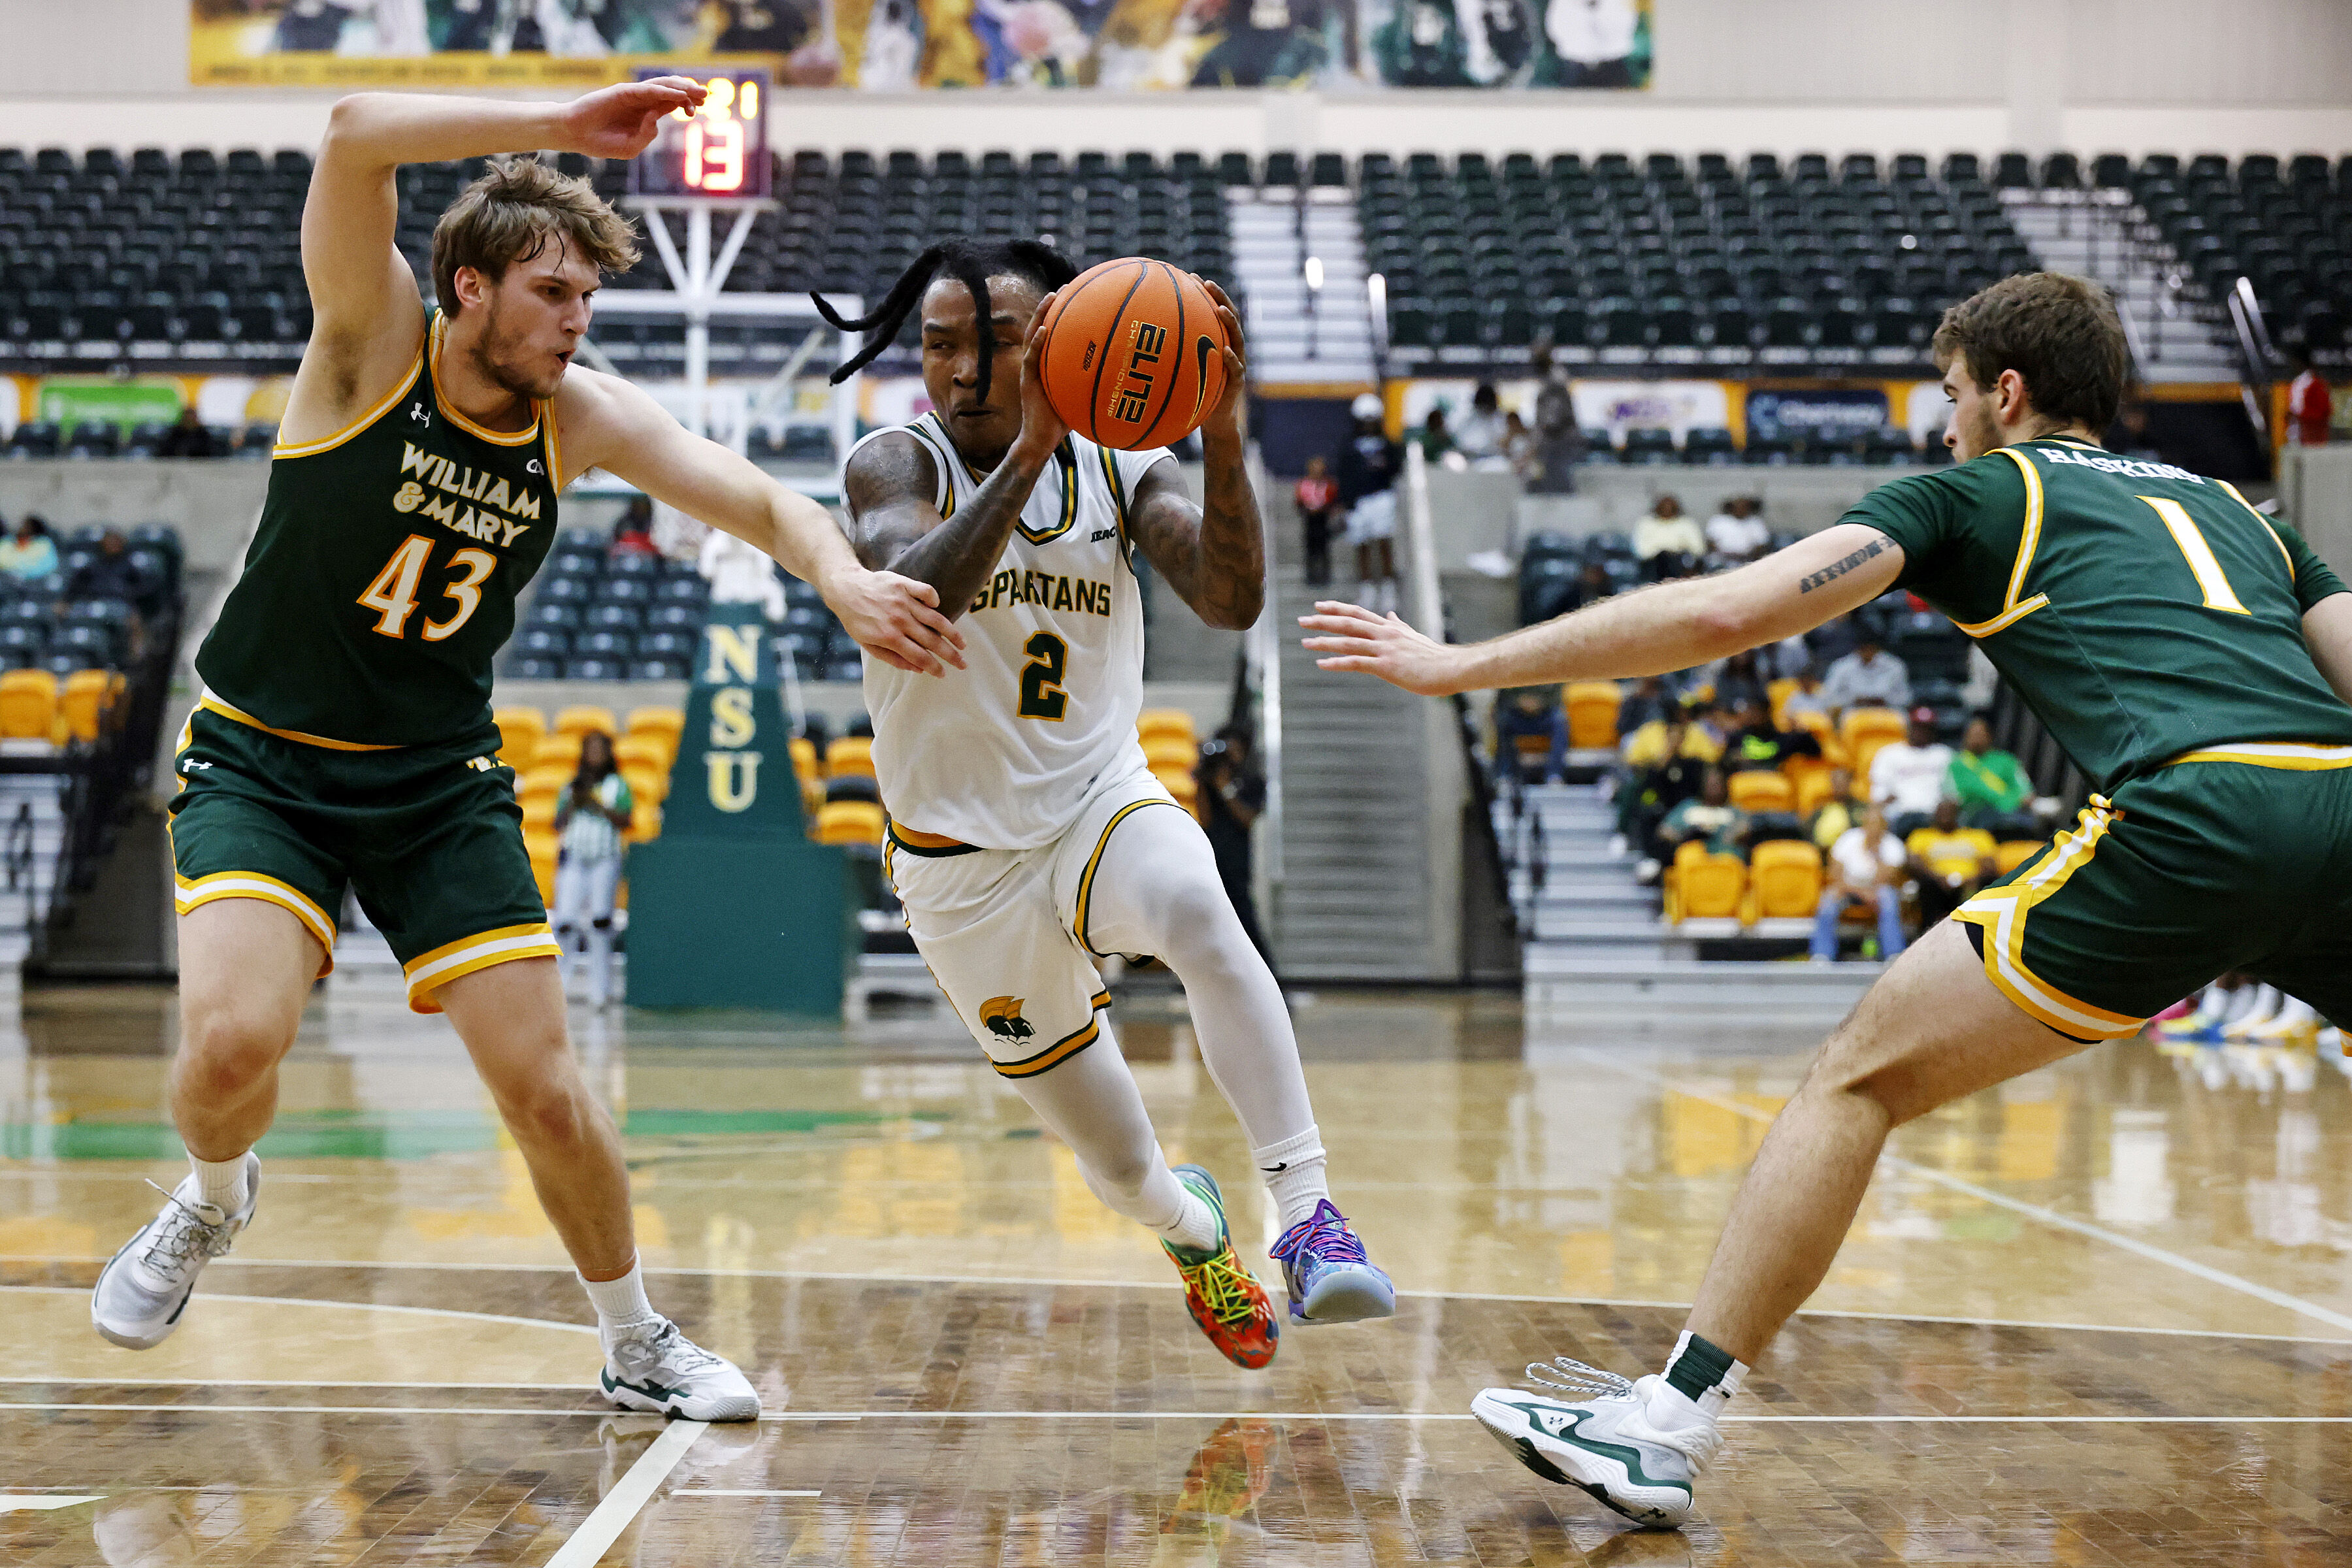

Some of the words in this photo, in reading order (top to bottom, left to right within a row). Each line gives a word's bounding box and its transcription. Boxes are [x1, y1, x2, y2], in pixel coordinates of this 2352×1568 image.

[683, 119, 745, 190] 13
[1114, 322, 1167, 424] ELITE
[393, 481, 426, 513] &
[417, 493, 531, 547] MARY
[400, 440, 540, 520] WILLIAM
[356, 533, 497, 642] 43
[2134, 495, 2252, 615] 1
[701, 623, 764, 813] NSU
[1017, 630, 1069, 722] 2
